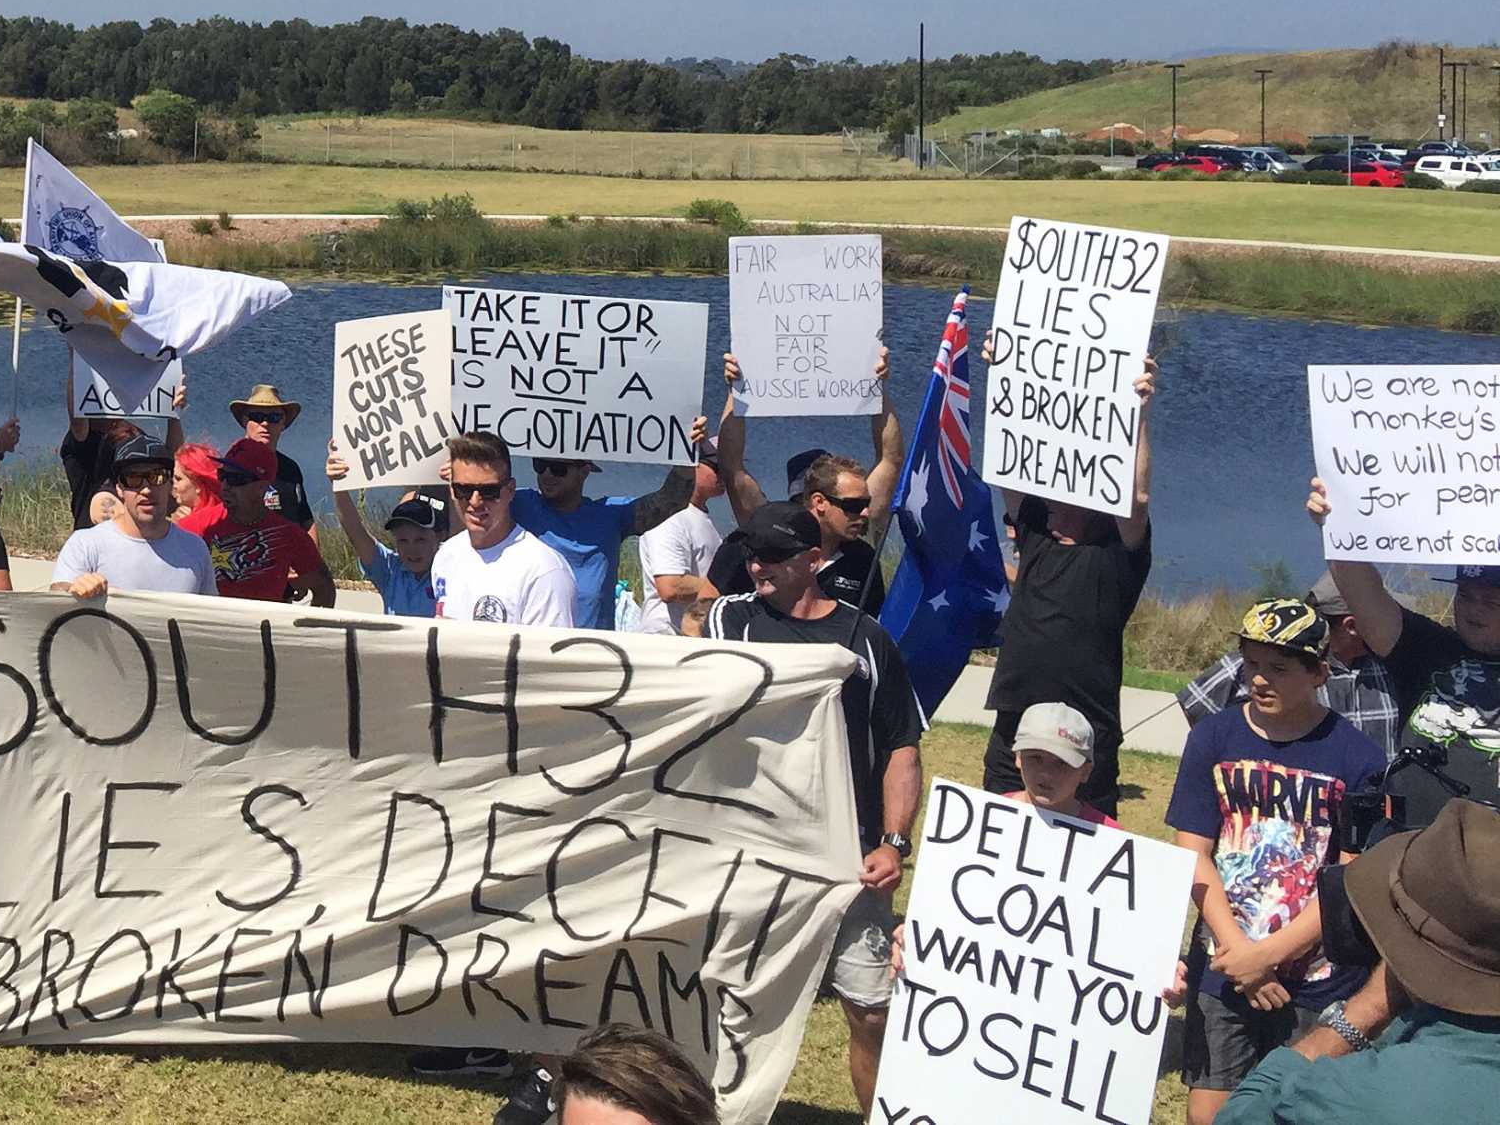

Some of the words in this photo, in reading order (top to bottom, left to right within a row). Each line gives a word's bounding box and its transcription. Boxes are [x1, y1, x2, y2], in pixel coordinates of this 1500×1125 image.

[735, 244, 777, 273] FAIR
[823, 244, 881, 270] WORK
[1009, 219, 1159, 294] $OUTH32
[562, 299, 591, 330] IT
[597, 302, 658, 337] OR
[756, 280, 881, 305] AUSTRALIA?
[1013, 279, 1111, 340] LIES
[341, 323, 426, 377] THESE
[452, 326, 581, 366] LEAVE
[774, 314, 833, 334] NOT
[775, 337, 828, 355] FAIR
[348, 356, 425, 413] CUTS
[451, 359, 486, 389] IS
[511, 363, 598, 395] NOT
[618, 372, 654, 400] A
[741, 378, 810, 399] AUSSIE
[817, 378, 883, 398] WORKERS
[776, 356, 832, 374] FOR
[991, 327, 1131, 393] DECEIPT
[1322, 371, 1374, 403] We
[1387, 377, 1440, 396] are
[1452, 375, 1500, 398] not
[343, 387, 427, 449] WON'T
[451, 403, 696, 463] NEGOTIATION
[1021, 381, 1136, 447] BROKEN
[1351, 405, 1496, 441] monkey's
[359, 411, 451, 481] HEAL!
[996, 428, 1124, 505] DREAMS
[1332, 446, 1382, 475] We
[1393, 442, 1446, 475] will
[1358, 486, 1410, 516] for
[1329, 531, 1368, 551] We
[1376, 534, 1413, 551] are
[1417, 530, 1454, 553] not
[1221, 767, 1332, 826] MARVE
[927, 785, 1135, 910] DELTA
[367, 792, 840, 981] DECEIT
[951, 864, 1134, 980] COAL
[911, 919, 1053, 1003] WANT
[1067, 969, 1162, 1035] YOU
[387, 924, 754, 1094] DREAMS
[902, 978, 969, 1056] TO
[973, 1012, 1130, 1125] SELL
